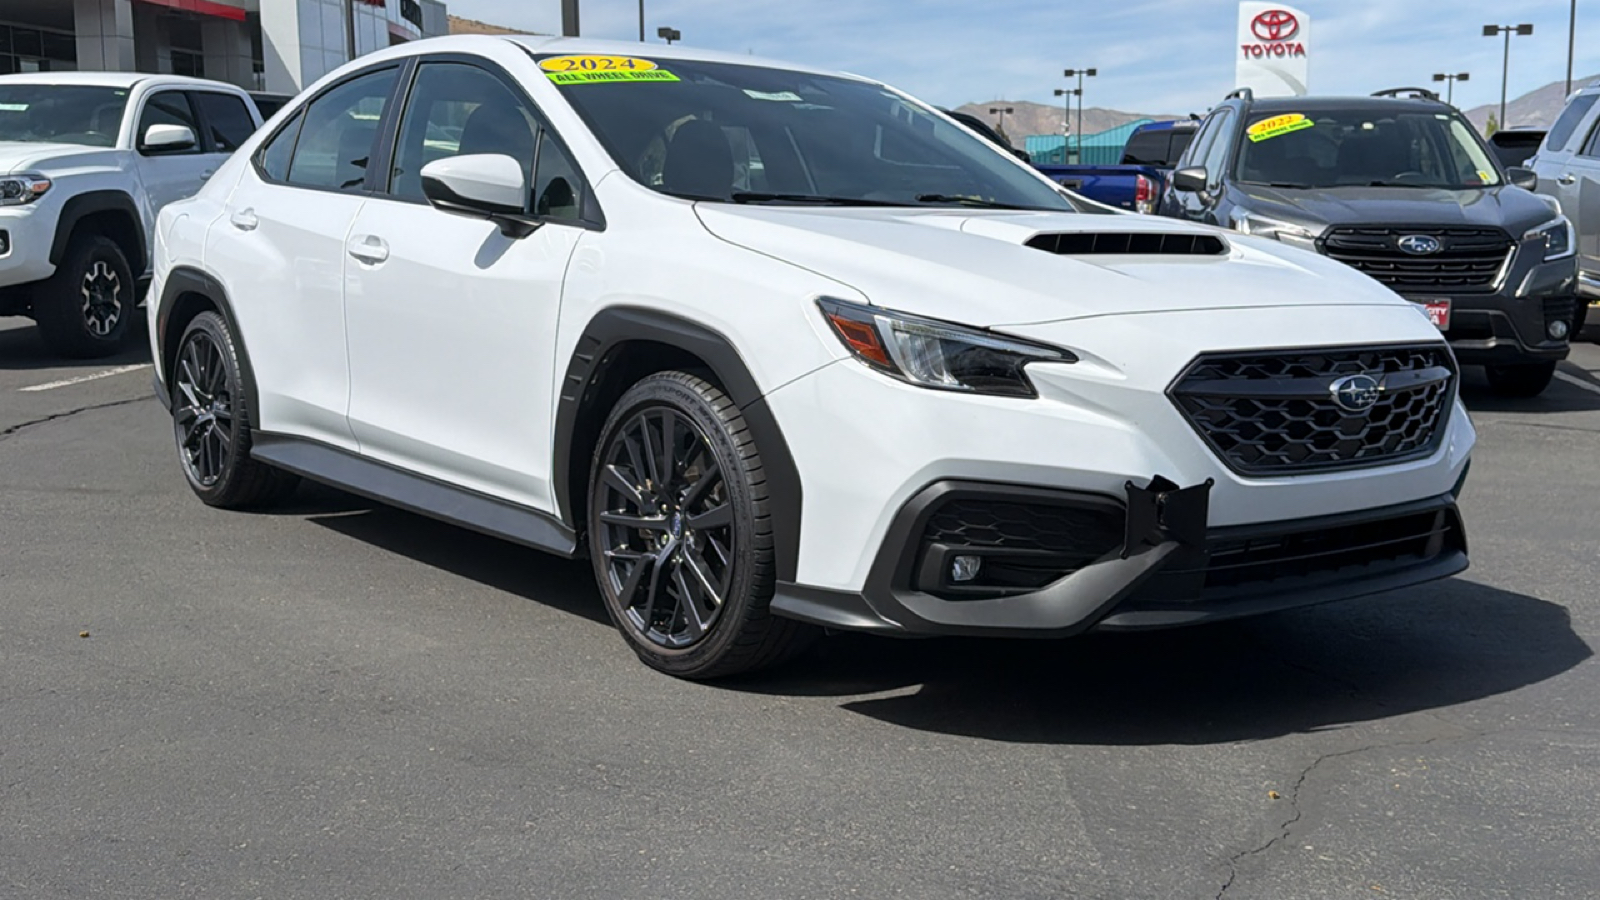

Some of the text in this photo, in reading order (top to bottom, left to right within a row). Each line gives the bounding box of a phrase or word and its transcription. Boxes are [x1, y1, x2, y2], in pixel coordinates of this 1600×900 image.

[1241, 42, 1306, 59] TOYOTA
[560, 58, 636, 71] 2024
[556, 71, 670, 82] ALL WHEEL DRIVE
